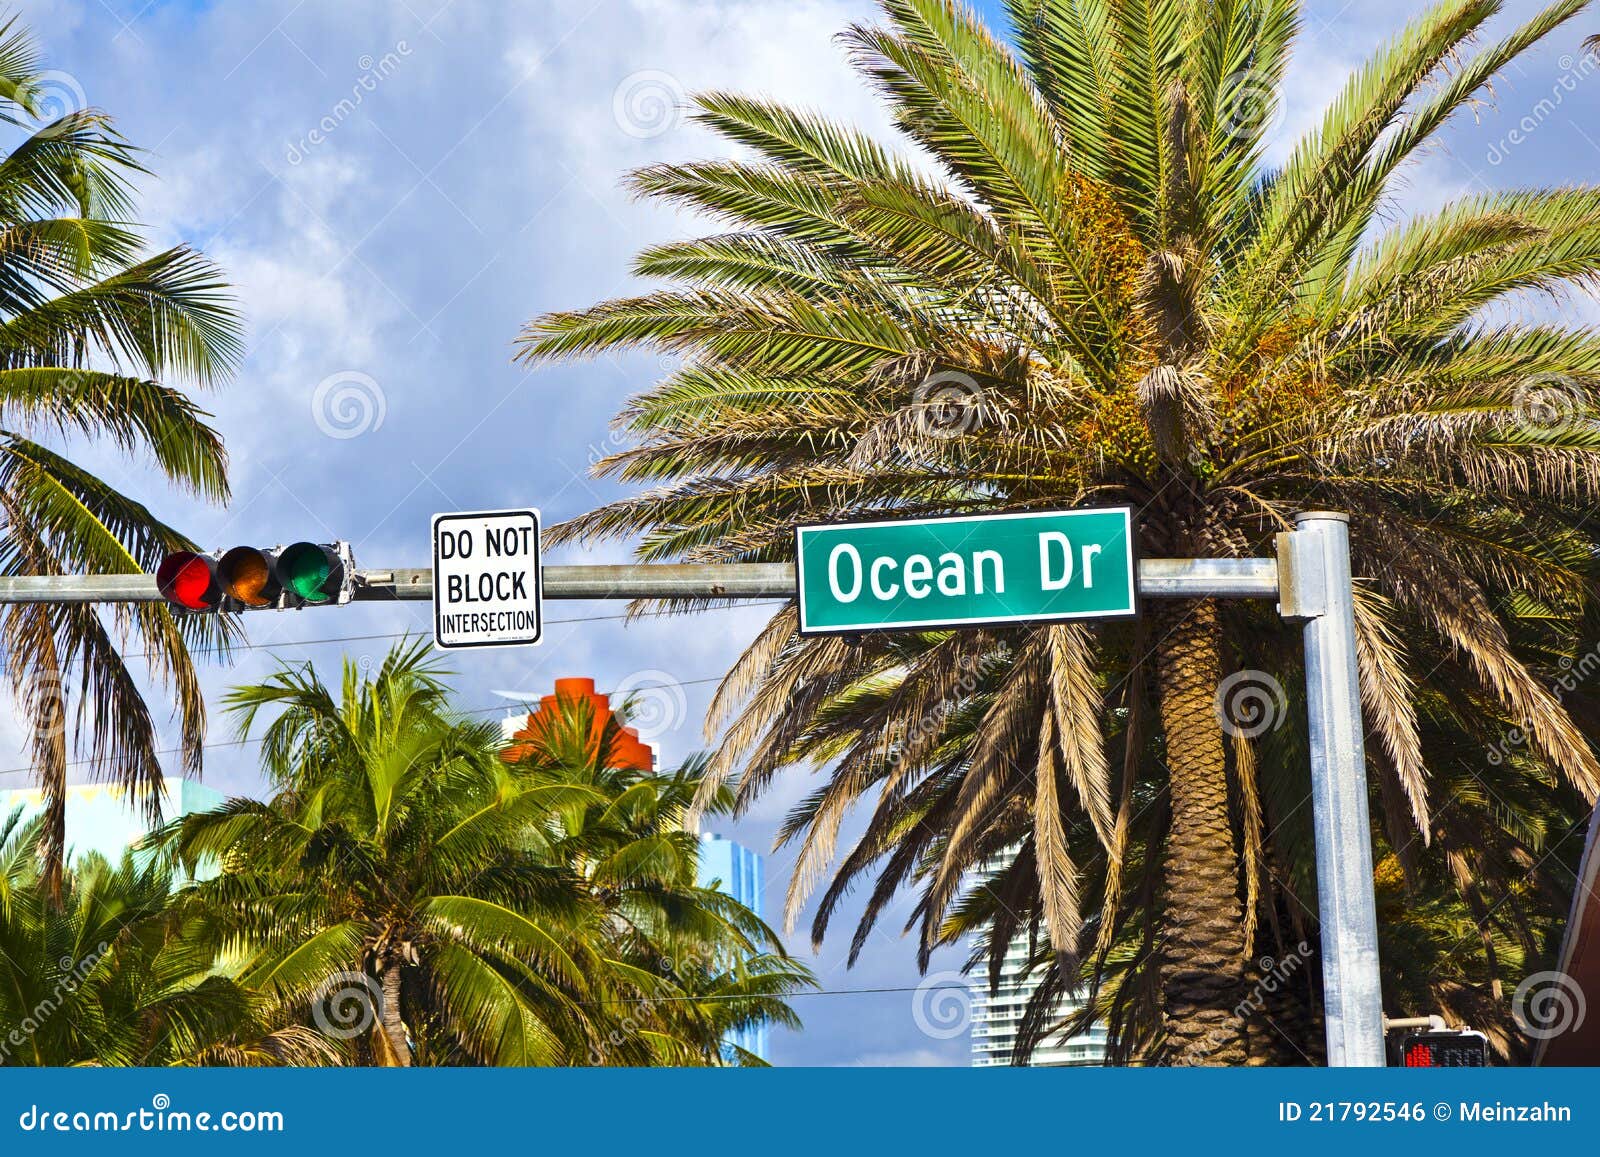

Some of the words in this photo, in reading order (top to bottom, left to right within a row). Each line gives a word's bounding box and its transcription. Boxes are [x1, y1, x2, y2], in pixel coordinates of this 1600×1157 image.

[441, 530, 473, 559] DO
[486, 527, 532, 557] NOT
[828, 543, 1005, 603] Ocean
[1038, 531, 1102, 591] Dr
[448, 571, 527, 603] BLOCK
[442, 610, 535, 634] INTERSECTION
